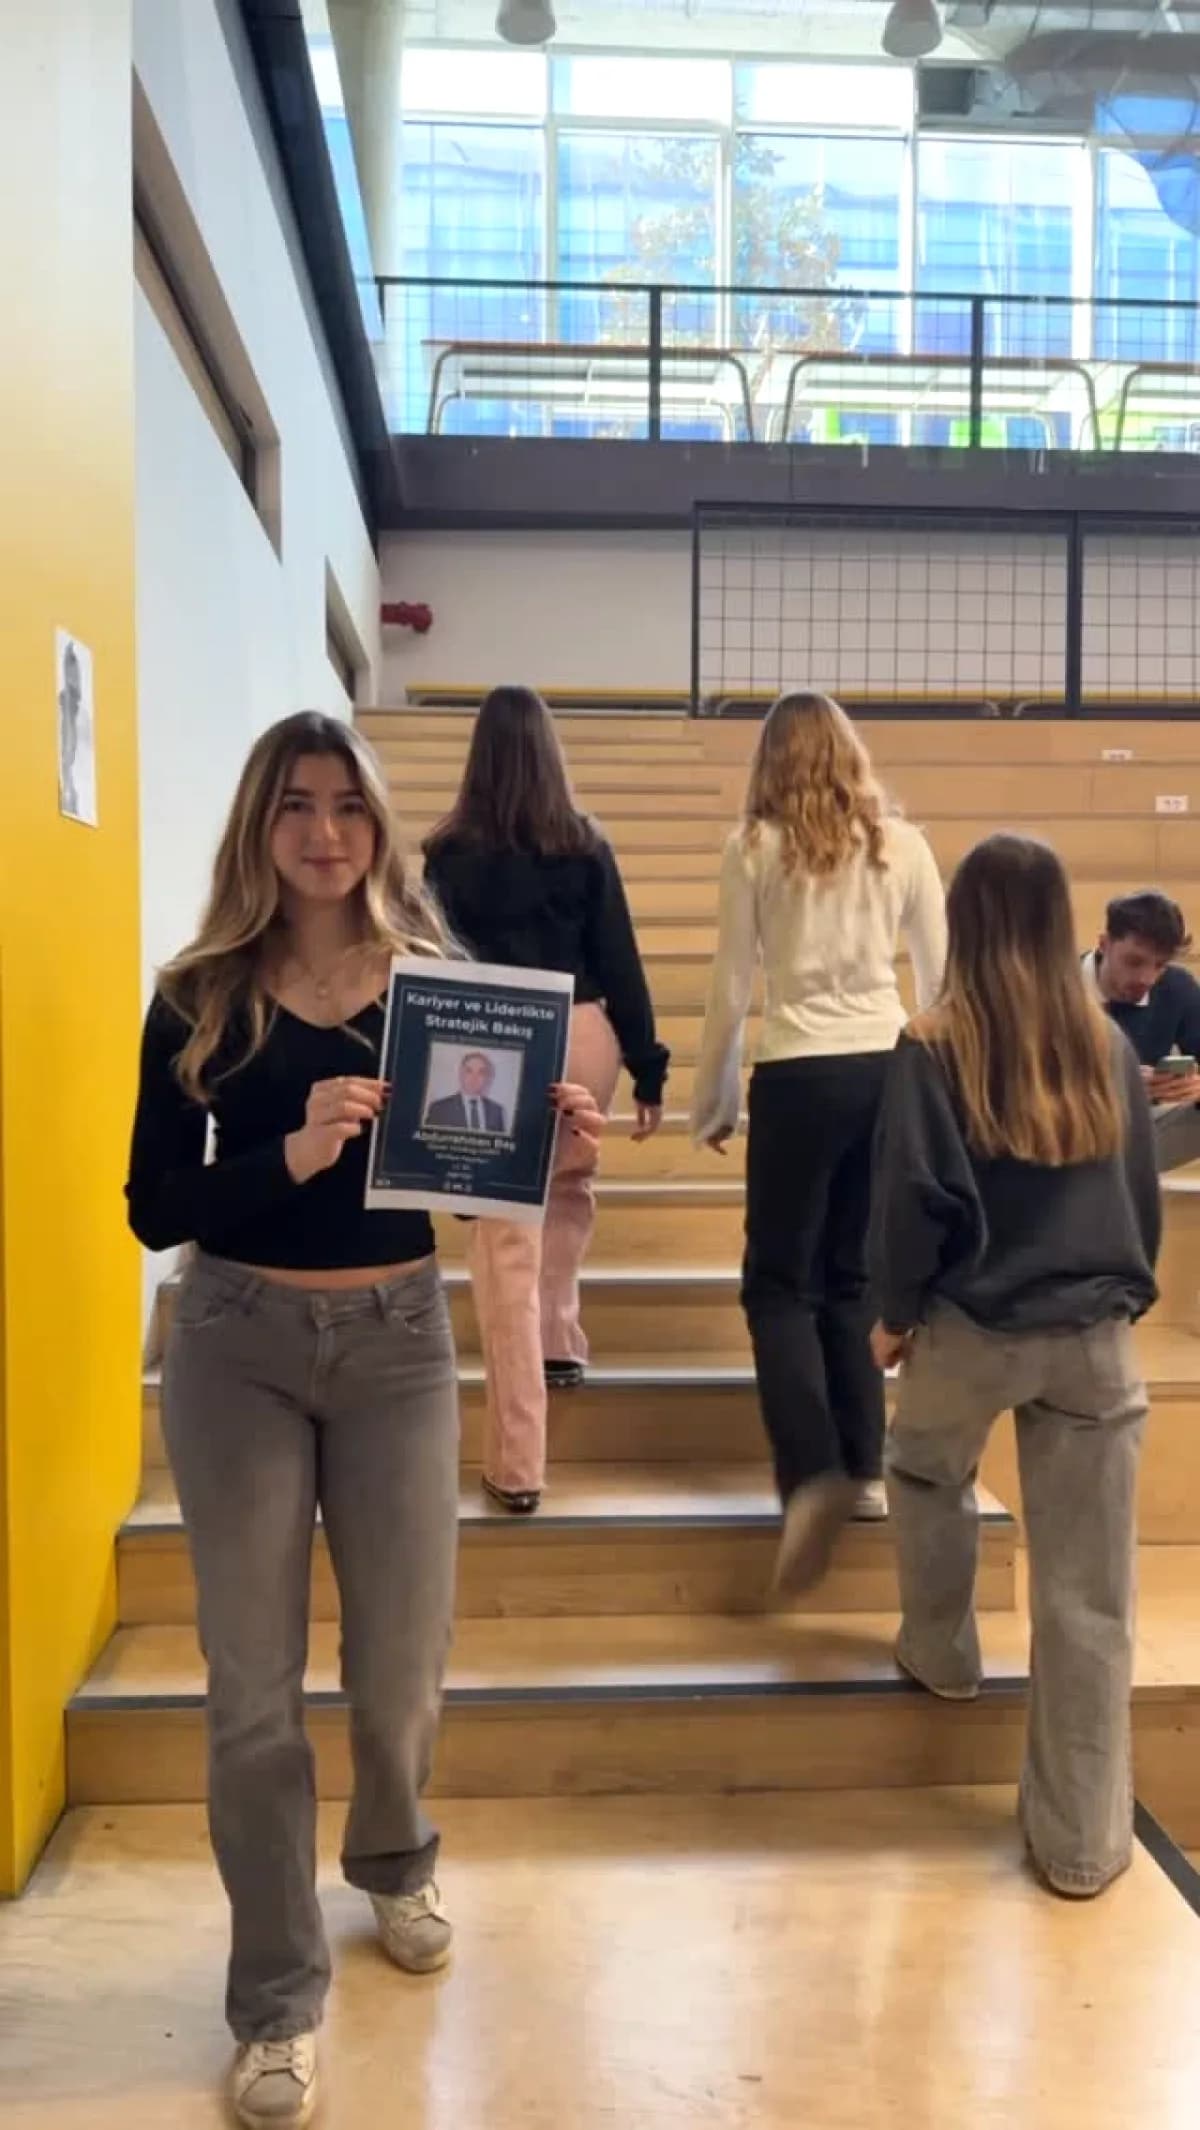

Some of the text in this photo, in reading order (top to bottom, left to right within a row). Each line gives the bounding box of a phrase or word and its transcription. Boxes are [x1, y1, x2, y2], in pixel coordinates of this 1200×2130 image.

[407, 992, 555, 1020] Kariyer ve Liderlikte
[425, 1014, 489, 1034] Stratejik
[492, 1022, 533, 1040] Bakış
